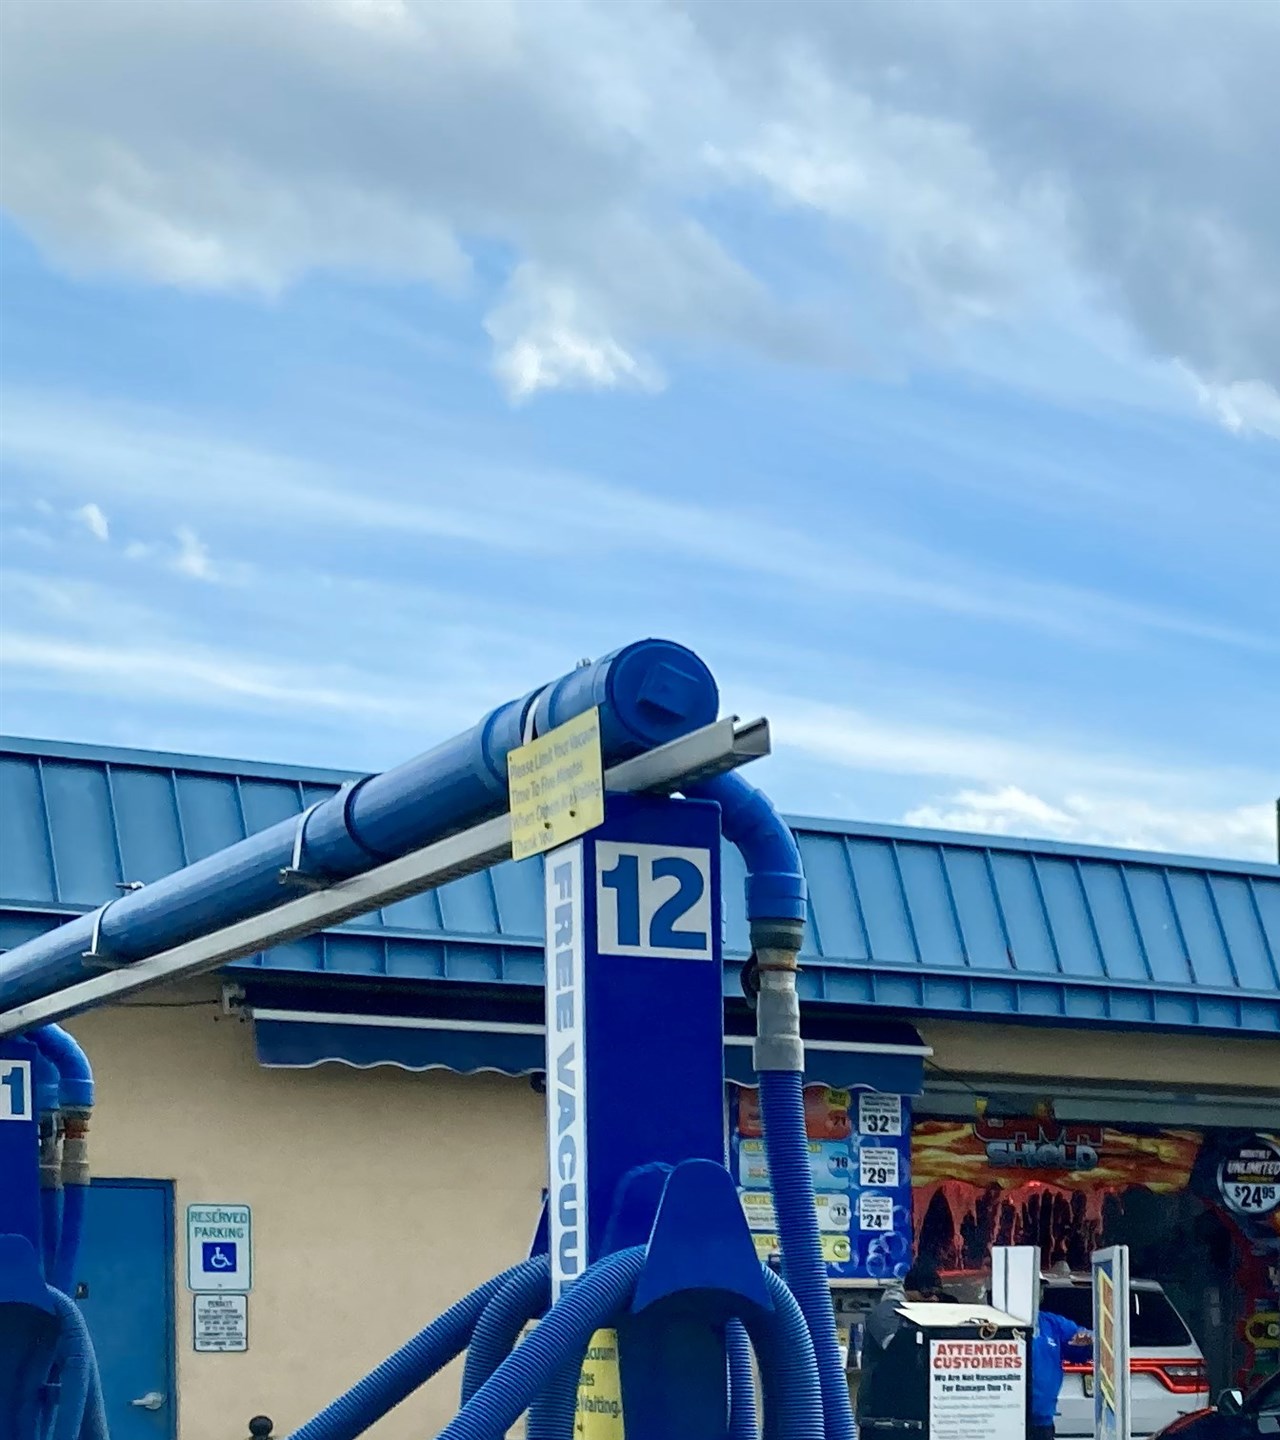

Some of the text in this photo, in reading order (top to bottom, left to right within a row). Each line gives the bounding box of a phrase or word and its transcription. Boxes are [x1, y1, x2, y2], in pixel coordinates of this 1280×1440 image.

[601, 853, 708, 952] 12
[552, 860, 580, 1292] FREE VACUU
[1, 1066, 25, 1115] 1
[190, 1211, 248, 1224] RESERVED
[194, 1227, 244, 1239] PARKING
[937, 1344, 1019, 1356] ATTENTION
[933, 1356, 1023, 1369] CUSTOMERS
